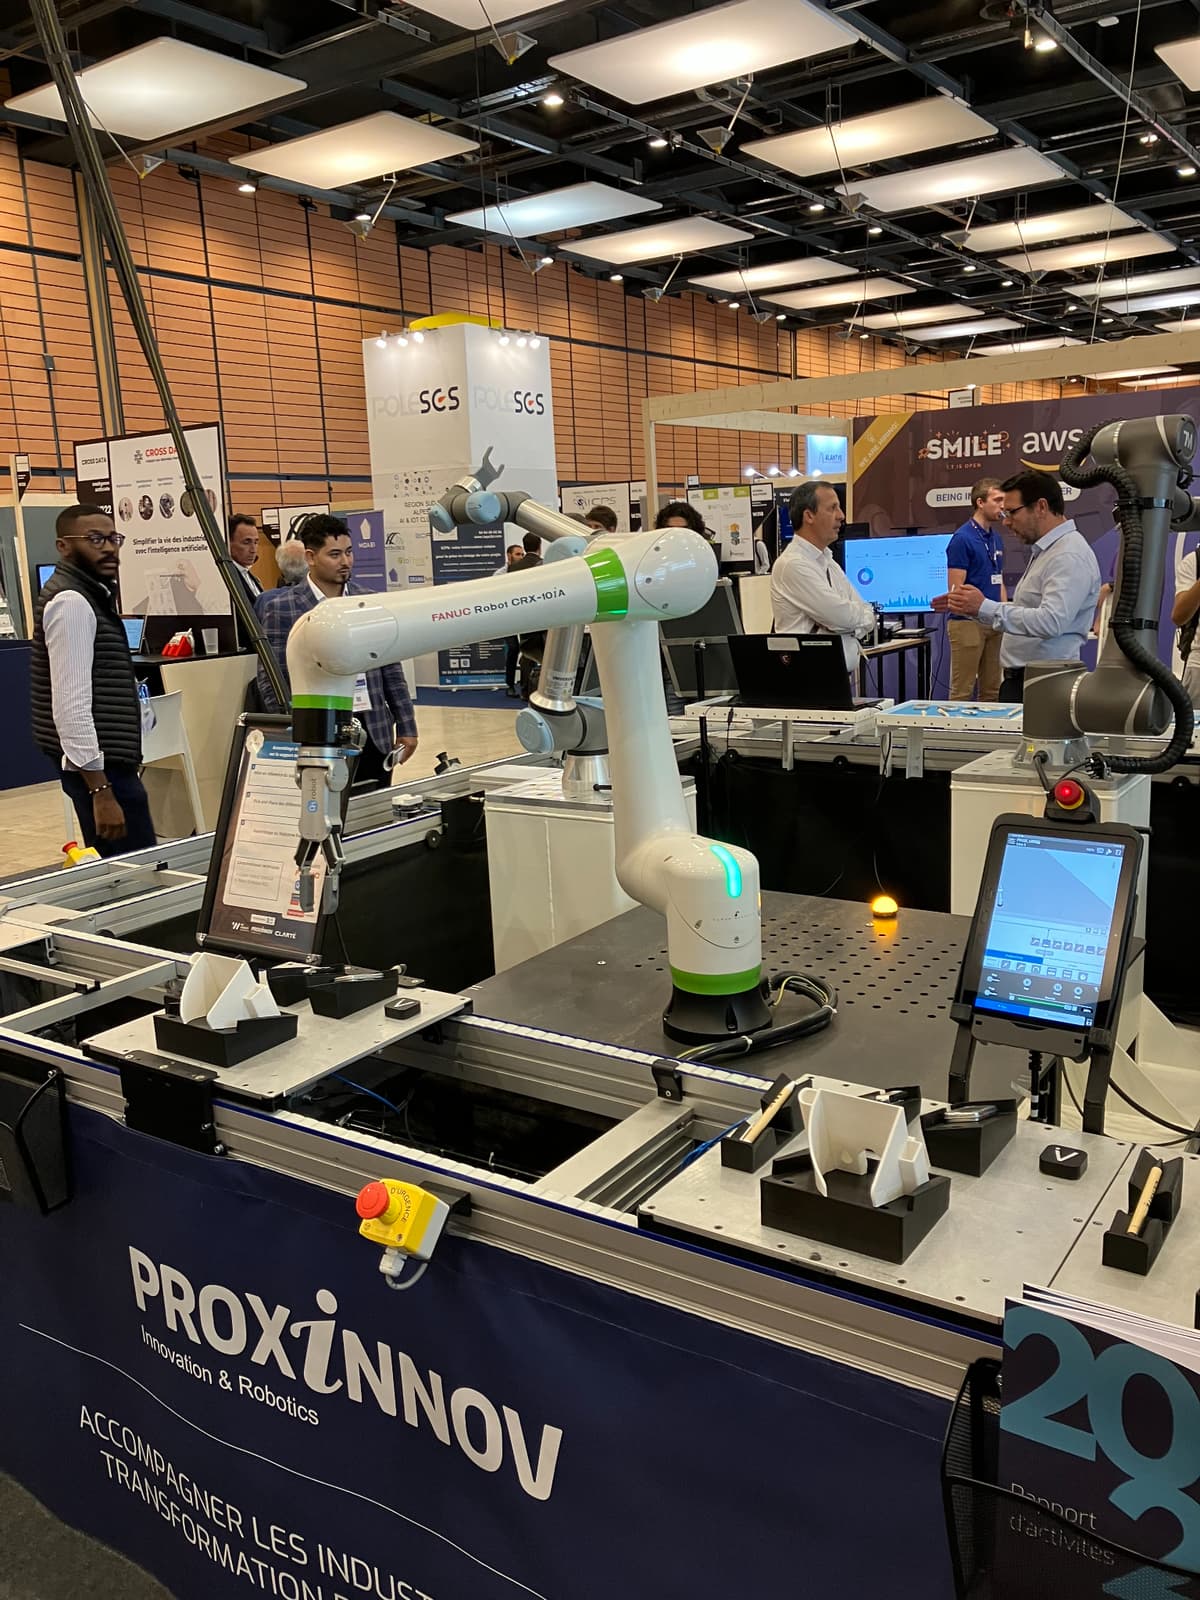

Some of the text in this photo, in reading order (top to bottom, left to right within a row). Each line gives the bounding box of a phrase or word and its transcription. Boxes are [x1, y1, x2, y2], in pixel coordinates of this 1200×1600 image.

[145, 447, 167, 457] CROSS
[927, 434, 1001, 460] SMILE
[1022, 428, 1084, 454] aws
[936, 493, 962, 502] BEING
[133, 536, 157, 546] Simplifier
[158, 536, 162, 544] la
[163, 536, 171, 544] vie
[173, 534, 182, 543] des
[181, 543, 208, 552] artificielle
[431, 587, 566, 622] FANUC Robot CRX-10iA
[390, 1187, 412, 1224] D'URGENCE
[141, 1324, 320, 1426] Innovation & Robotics
[80, 1405, 245, 1538] ACCOMPAGNER
[252, 1516, 308, 1565] LES
[100, 1450, 323, 1600] TRANSFORMATION
